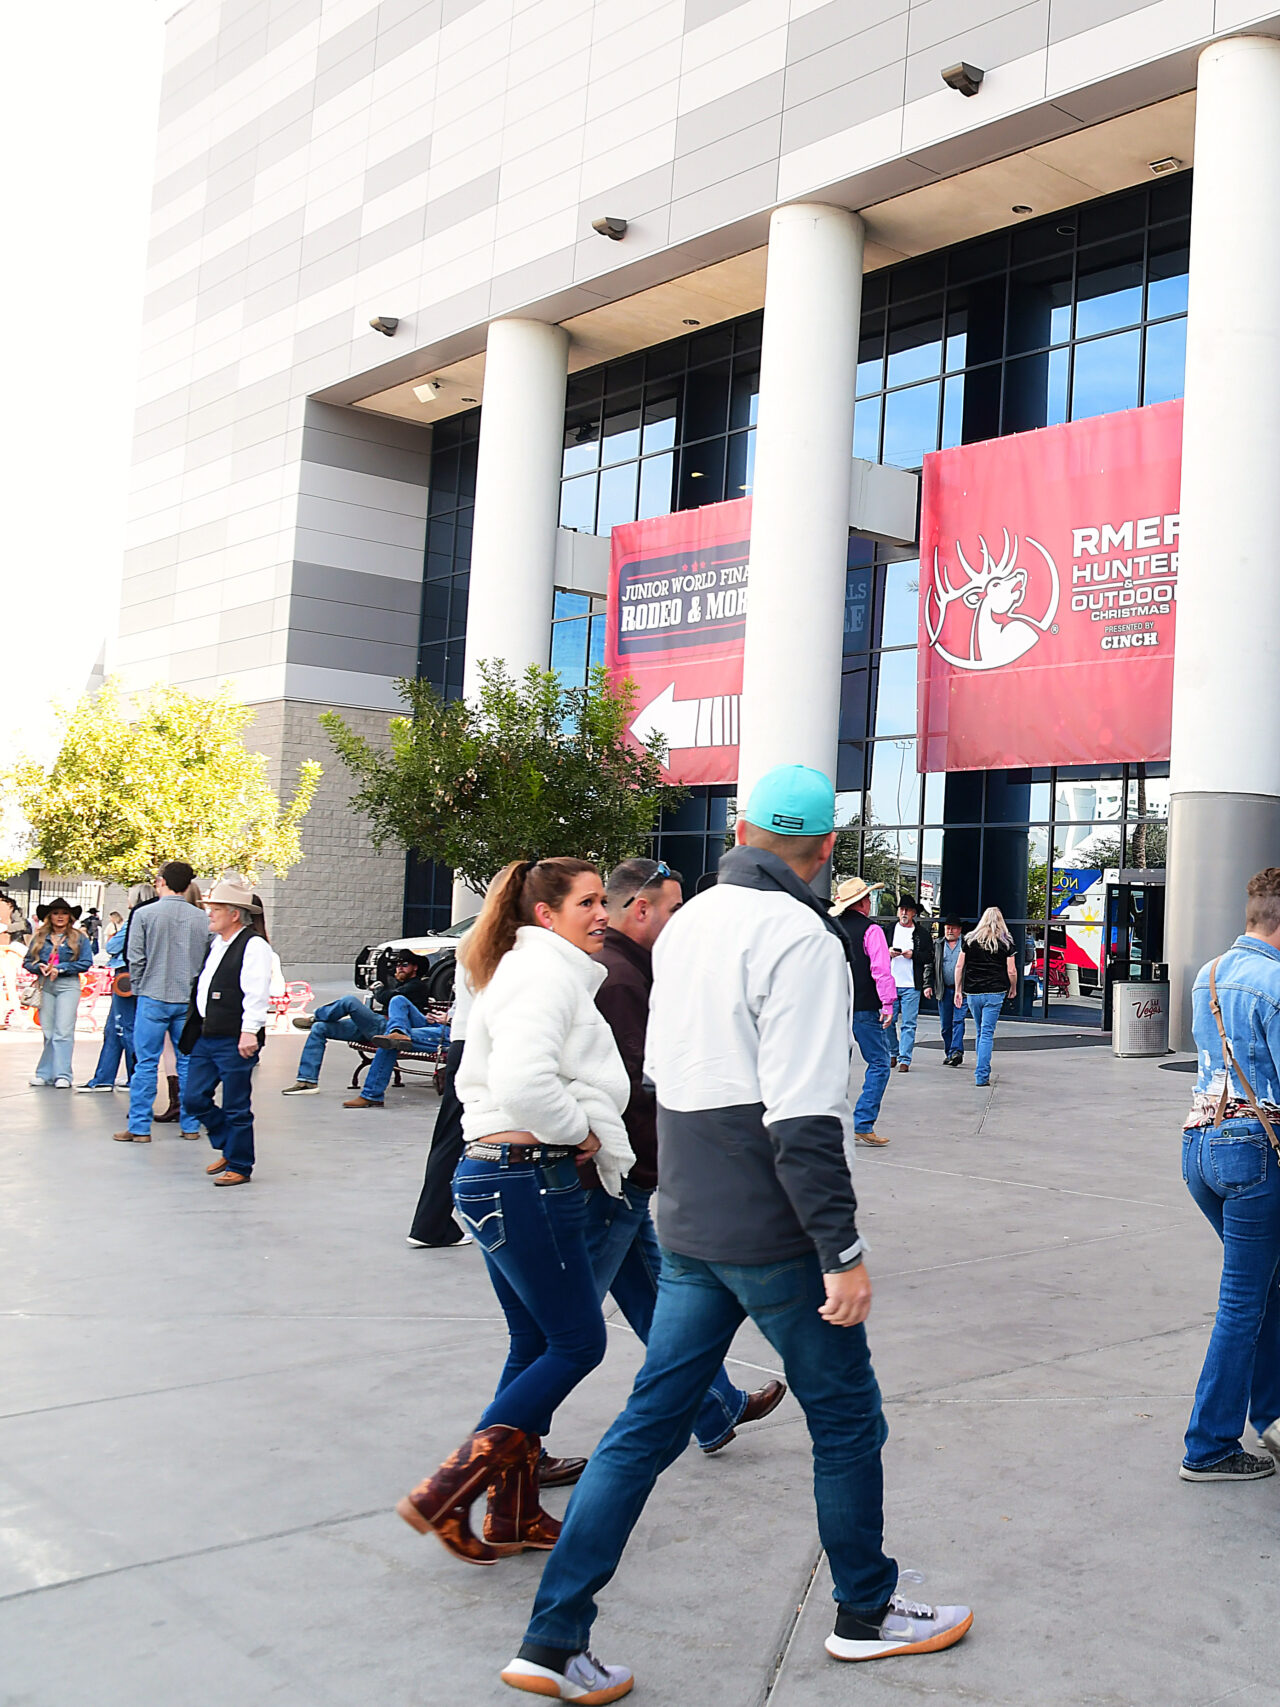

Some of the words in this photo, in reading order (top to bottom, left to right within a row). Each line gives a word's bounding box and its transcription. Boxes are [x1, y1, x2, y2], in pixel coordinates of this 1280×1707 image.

[621, 580, 670, 602] JUNIOR
[671, 571, 717, 593] WORLD
[1123, 579, 1134, 589] &
[1071, 585, 1177, 612] OUTDOO
[620, 598, 683, 632] RODEO
[687, 595, 702, 624] &
[1091, 604, 1170, 621] CHRISTMAS
[1104, 622, 1143, 633] PRESENTED
[1145, 621, 1155, 630] BY
[1101, 632, 1160, 650] CINCH
